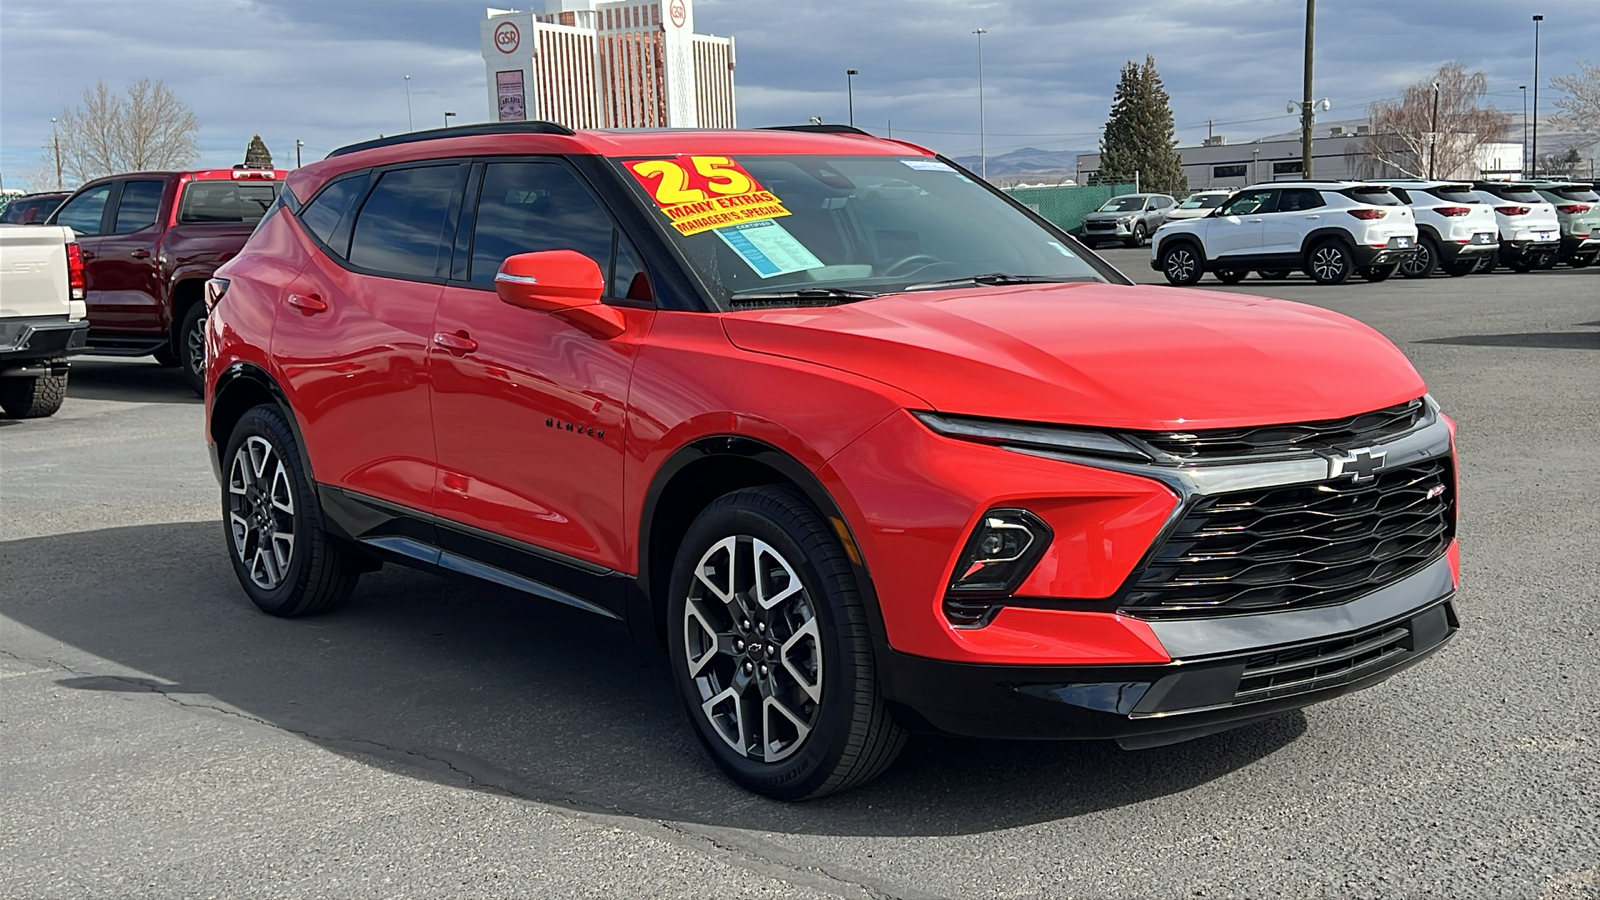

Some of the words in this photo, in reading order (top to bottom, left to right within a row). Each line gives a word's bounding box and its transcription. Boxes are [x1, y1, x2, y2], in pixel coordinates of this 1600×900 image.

[672, 5, 684, 19] GSR
[497, 30, 517, 45] GSR
[632, 156, 756, 204] 25
[667, 200, 715, 220] MANY
[716, 192, 775, 209] EXTRAS
[675, 212, 742, 233] MANAGER'S
[740, 205, 785, 219] SPECIAL
[735, 221, 772, 230] CERTIFIED
[545, 418, 605, 439] BLAZER
